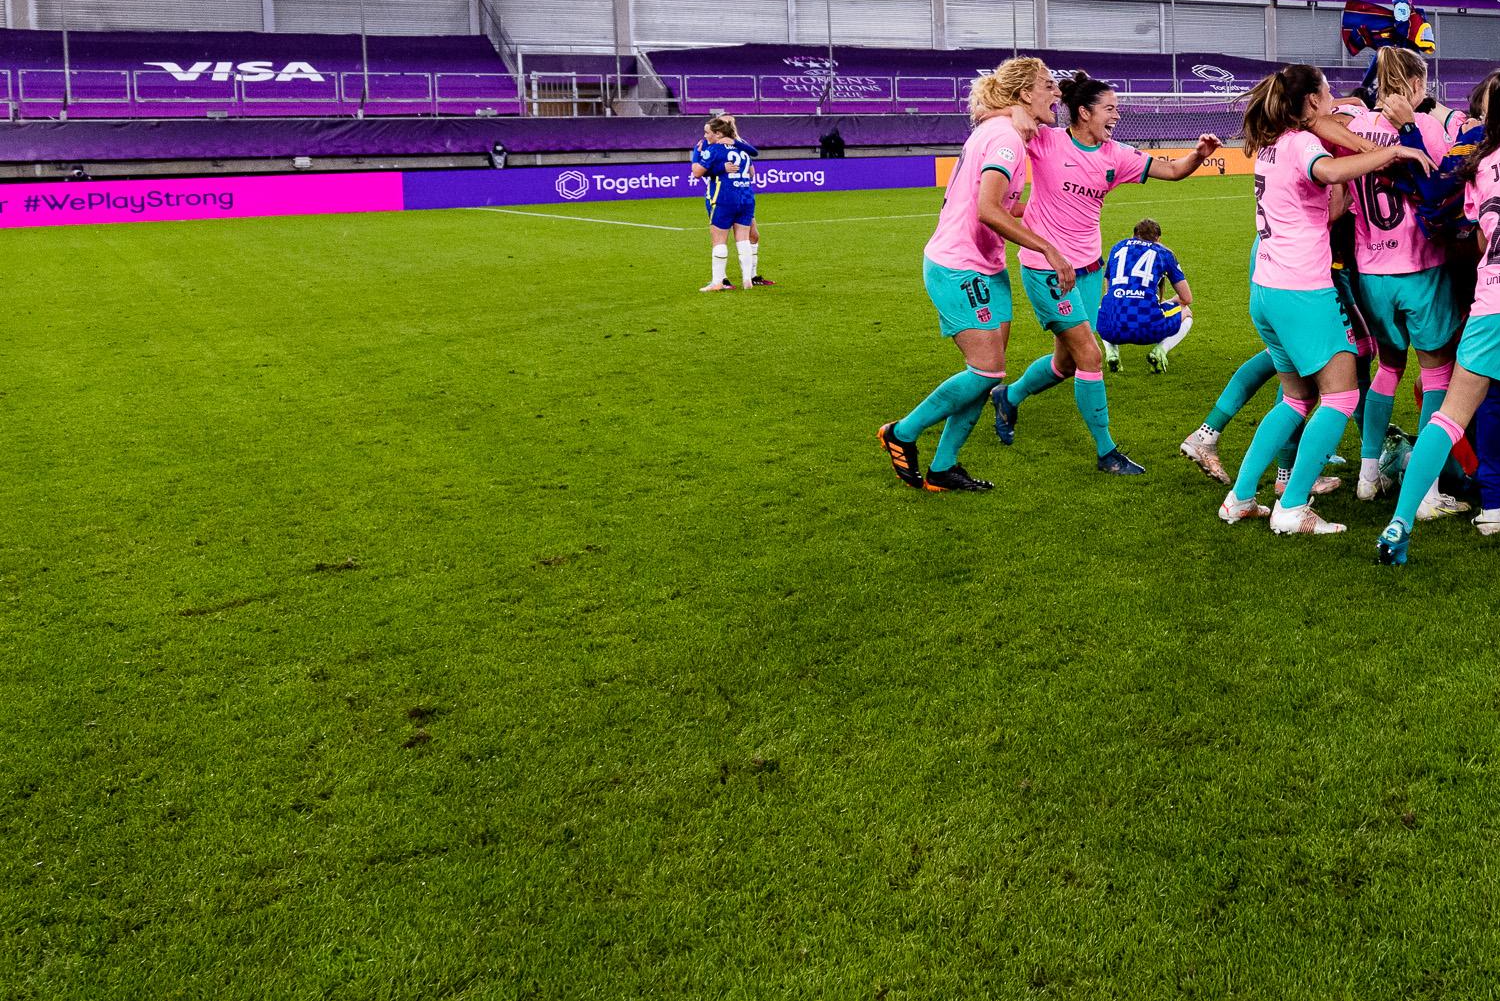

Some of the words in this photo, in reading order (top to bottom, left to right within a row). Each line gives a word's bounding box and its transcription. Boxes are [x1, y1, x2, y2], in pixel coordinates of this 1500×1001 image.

[143, 61, 325, 82] VISA
[727, 150, 750, 179] 22
[592, 174, 680, 194] Together
[24, 191, 234, 214] #WePlayStrong
[1352, 170, 1406, 231] 16
[1112, 246, 1158, 288] 14
[960, 276, 991, 309] 10
[1126, 289, 1145, 297] PLAN
